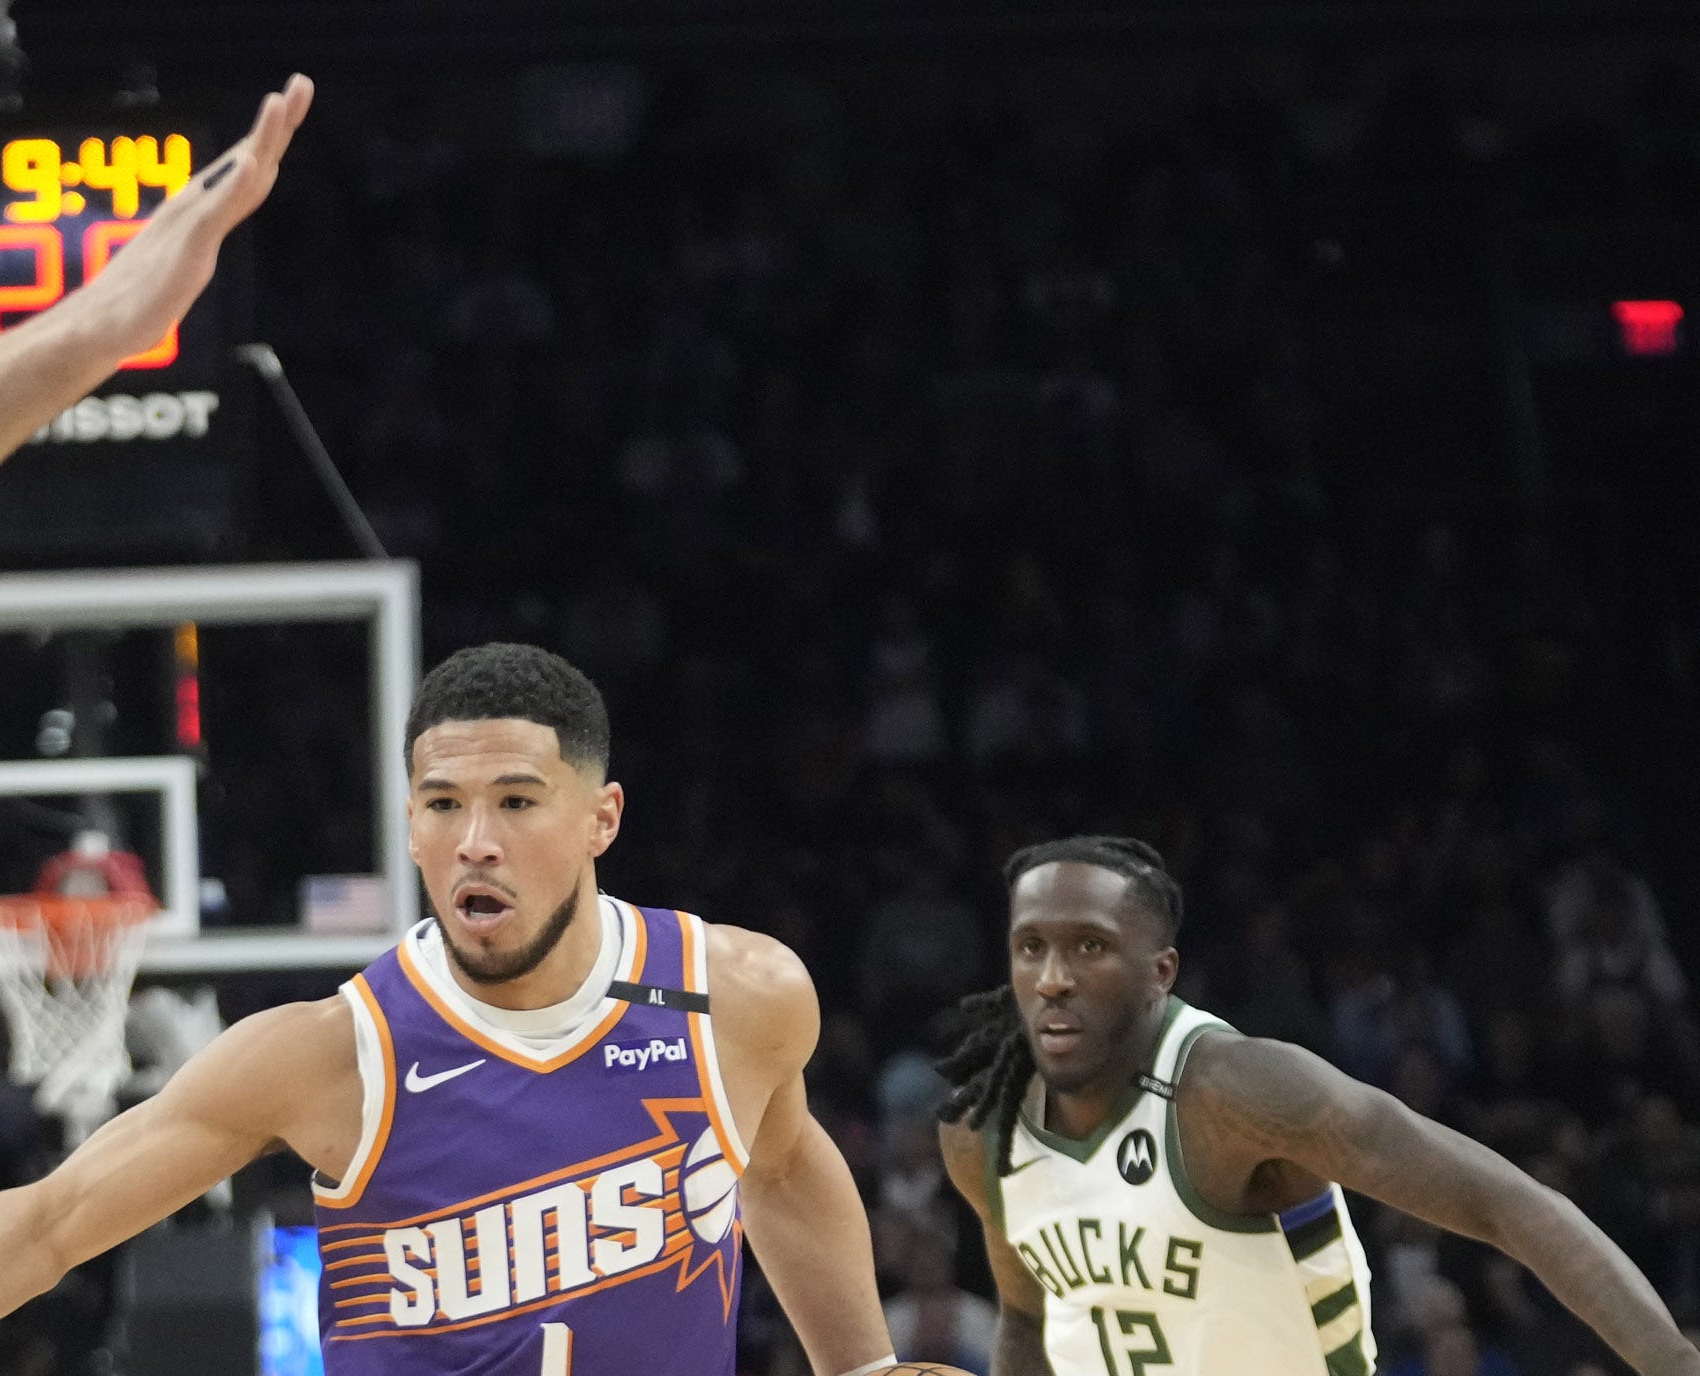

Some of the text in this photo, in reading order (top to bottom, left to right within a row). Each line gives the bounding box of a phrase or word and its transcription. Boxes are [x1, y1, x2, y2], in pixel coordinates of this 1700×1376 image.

[1, 133, 192, 222] 9:44
[31, 391, 220, 443] ISSOT
[648, 988, 666, 1005] AL
[604, 1037, 688, 1071] PayPal
[384, 1158, 666, 1327] SUNS
[1019, 1218, 1204, 1300] BUCKS
